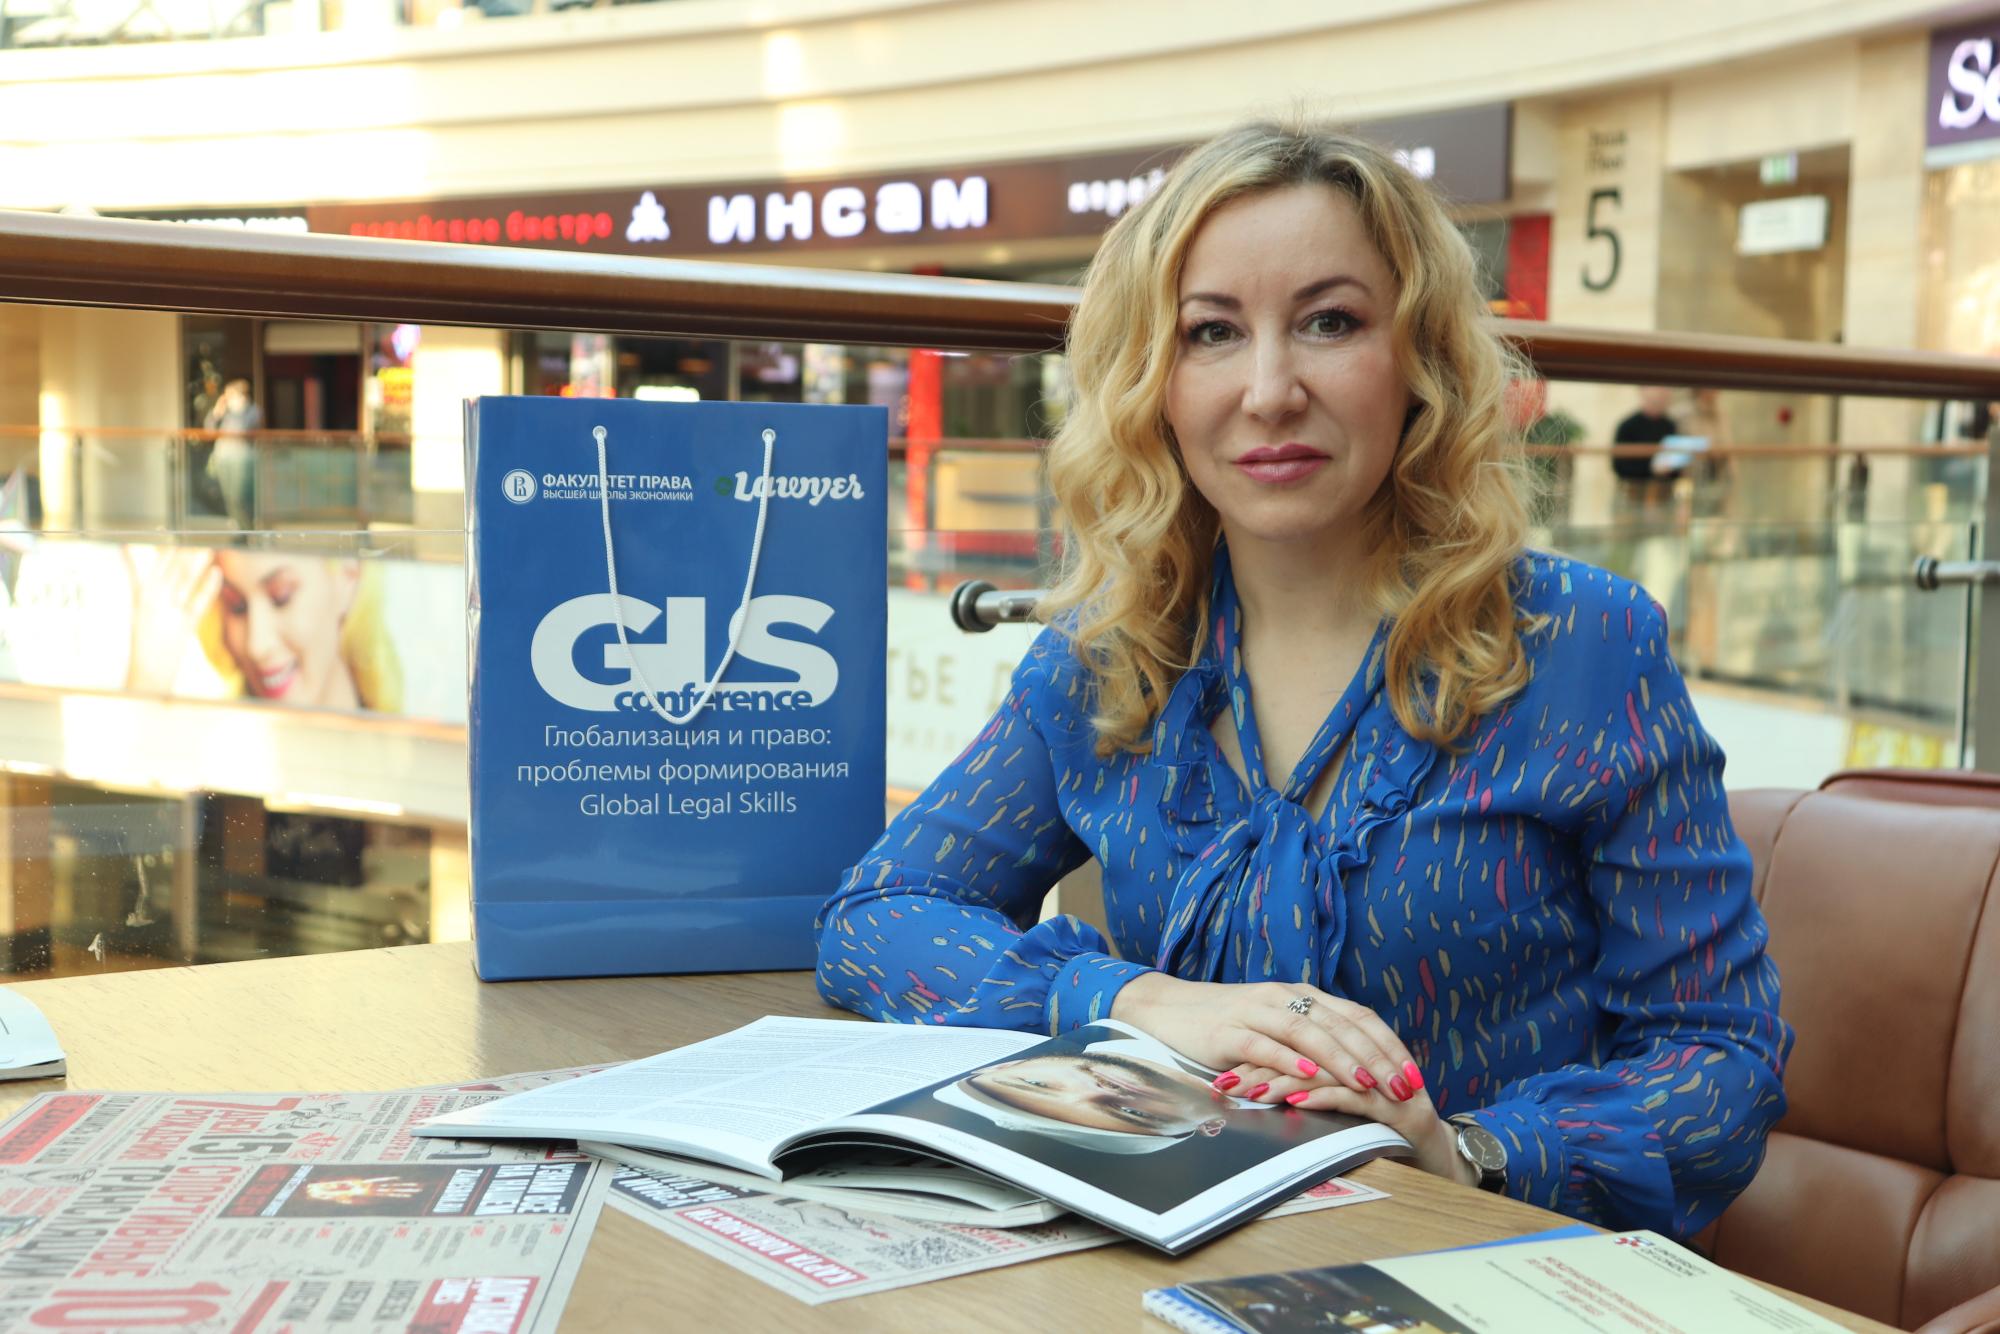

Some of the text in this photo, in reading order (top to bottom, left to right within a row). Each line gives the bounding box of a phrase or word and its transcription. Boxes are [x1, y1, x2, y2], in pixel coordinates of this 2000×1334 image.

[1580, 187, 1623, 293] 5
[543, 488, 587, 500] ВЫСШЕЙ
[629, 491, 693, 502] ЭКОНОМИКИ
[639, 475, 692, 490] ПРАВА
[531, 593, 839, 711] GLS
[544, 725, 832, 749] Глобализация и право:
[517, 758, 849, 786] проблемы формирования
[580, 790, 797, 819] Global Legal Skills
[69, 1166, 245, 1278] СПОРТИВНЫЕ
[778, 1252, 862, 1284] КАРТА
